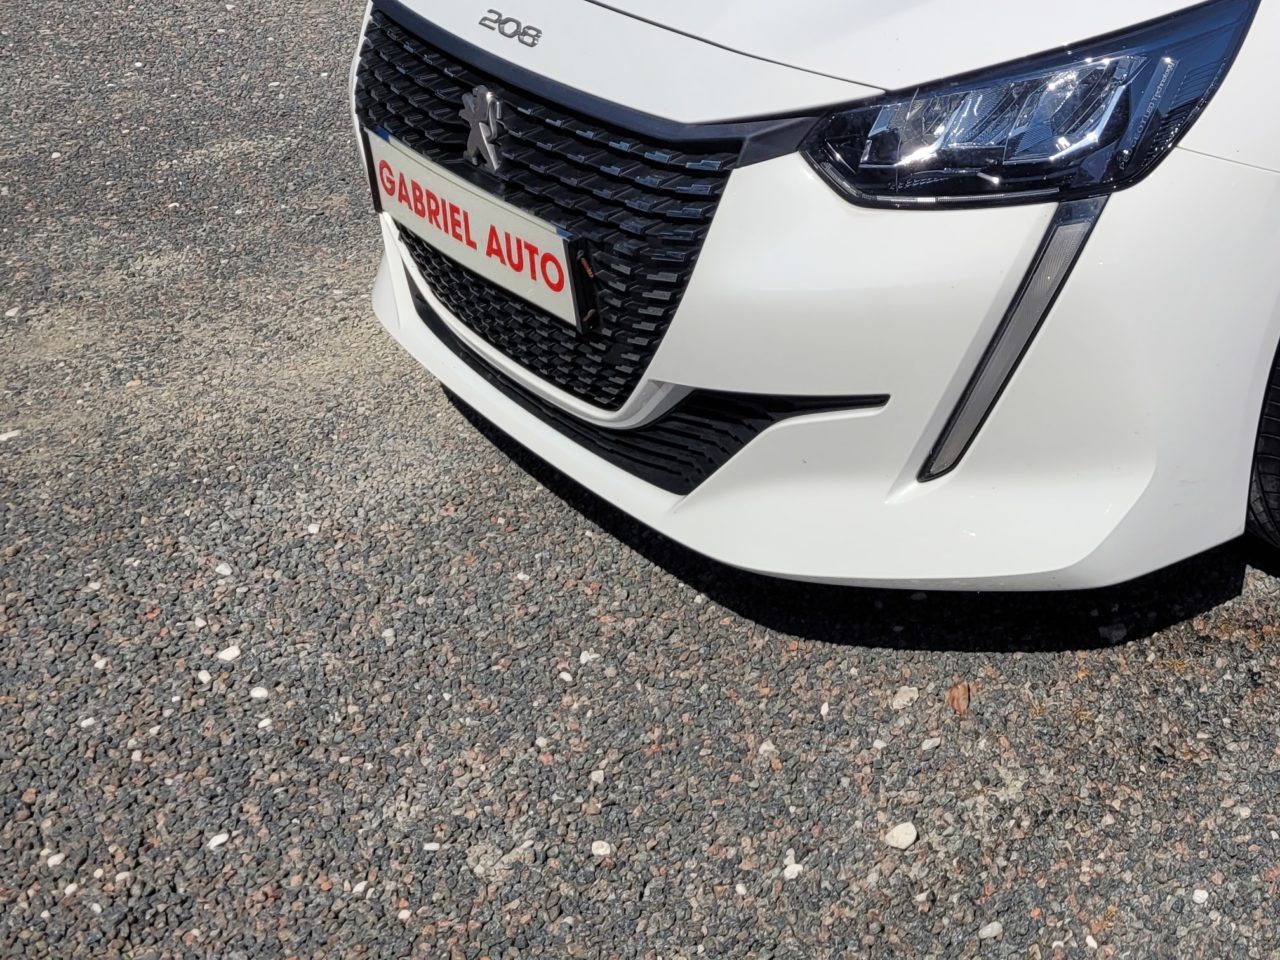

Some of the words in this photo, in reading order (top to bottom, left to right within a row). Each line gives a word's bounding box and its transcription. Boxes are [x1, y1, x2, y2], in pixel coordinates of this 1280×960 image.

[478, 8, 543, 48] 208
[378, 159, 478, 251] GABRIEL
[485, 224, 566, 292] AUTO
